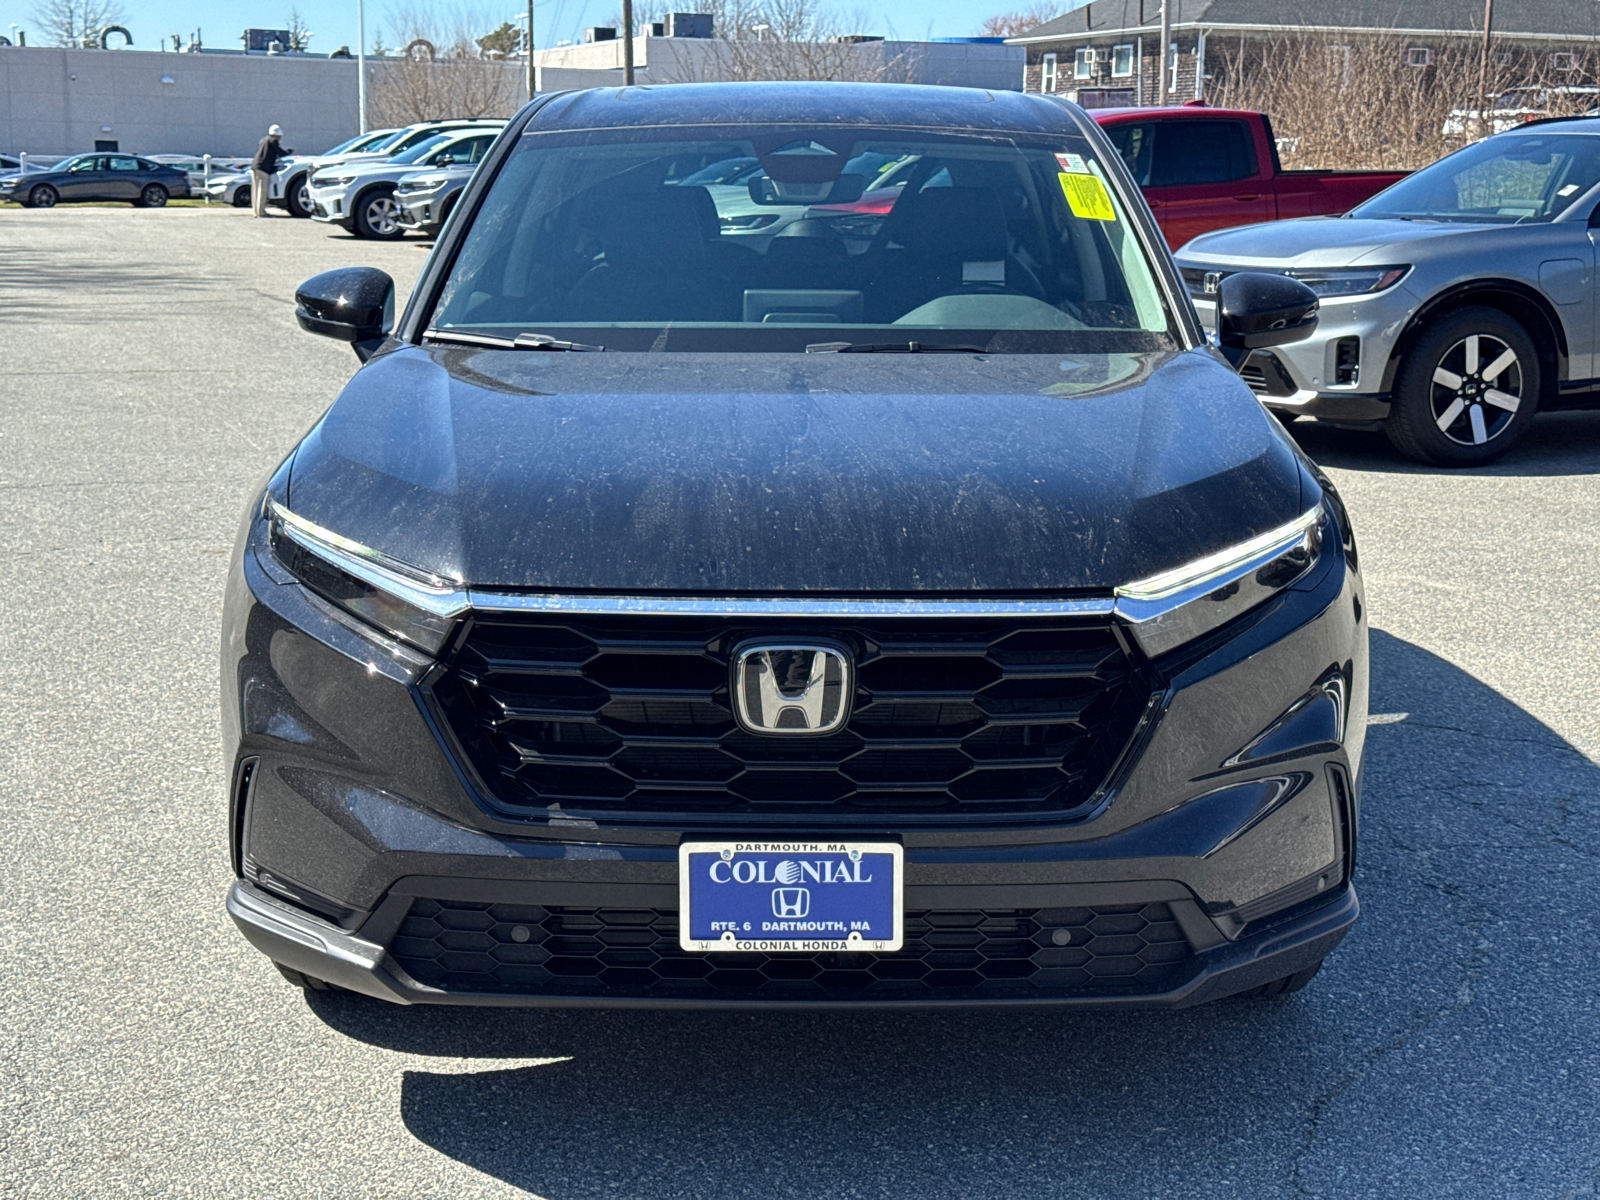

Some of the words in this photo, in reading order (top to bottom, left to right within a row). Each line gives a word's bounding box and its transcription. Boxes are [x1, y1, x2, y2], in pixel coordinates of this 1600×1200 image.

[827, 844, 847, 852] MA
[709, 860, 873, 884] COLONIAL
[711, 921, 740, 931] RTE.
[743, 921, 752, 931] 6
[762, 921, 848, 932] DARTMOUTH,
[850, 921, 871, 931] MA
[735, 941, 798, 950] COLONIAL
[802, 941, 848, 950] HONDA
